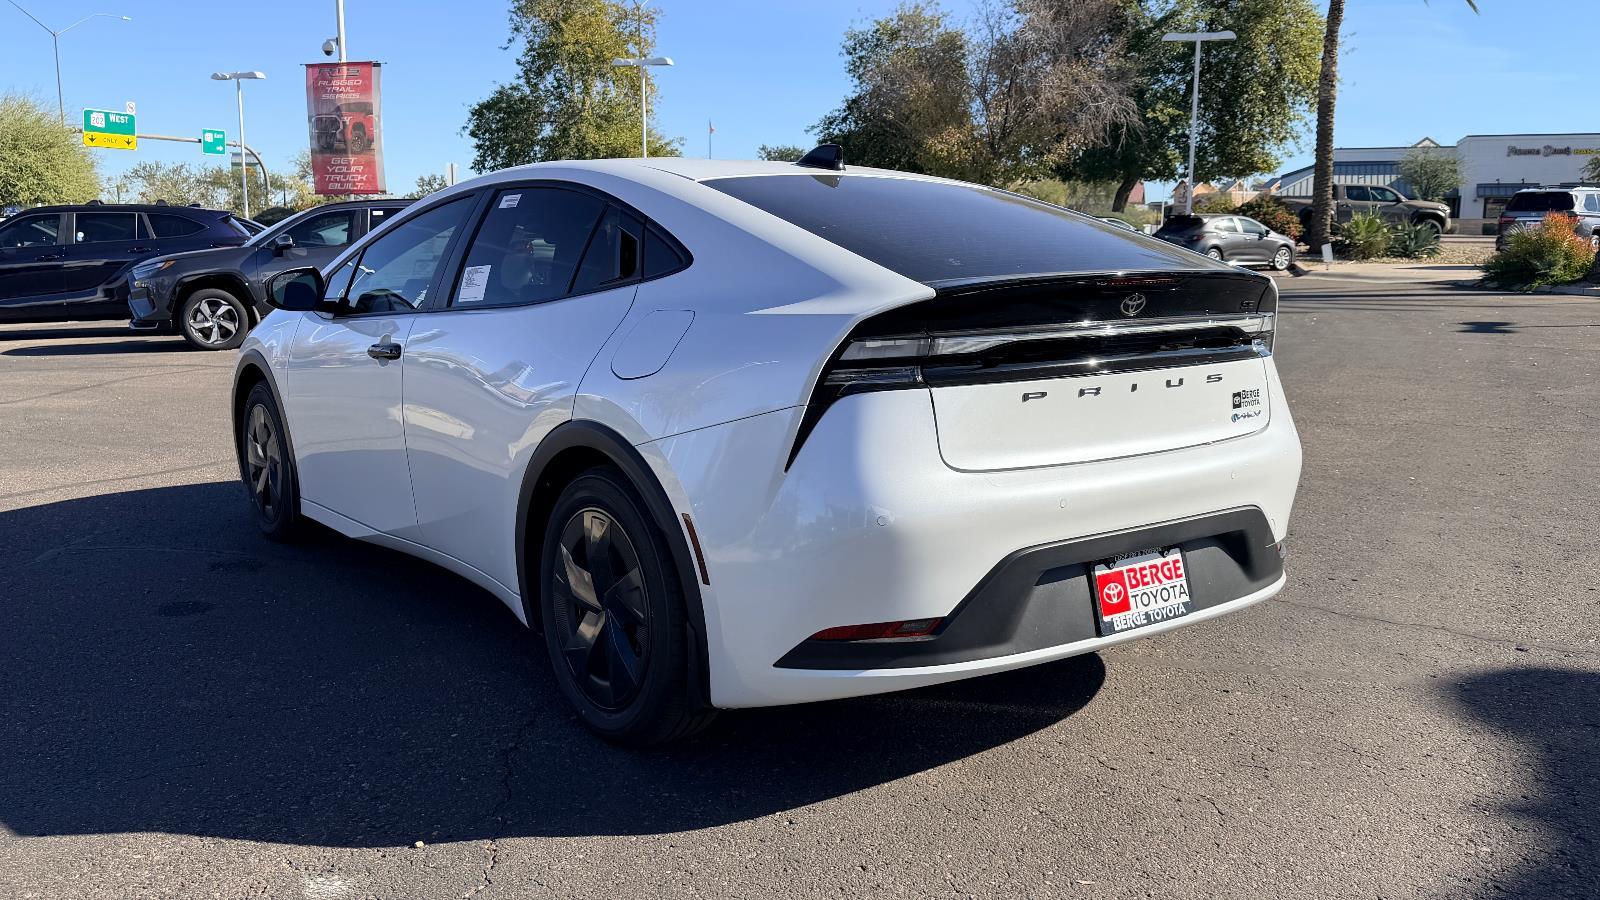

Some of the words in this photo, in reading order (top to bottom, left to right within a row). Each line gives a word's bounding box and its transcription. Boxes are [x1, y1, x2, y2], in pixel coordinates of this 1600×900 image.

[91, 116, 104, 126] 202
[109, 113, 128, 124] WEST
[331, 157, 358, 165] GET
[1022, 374, 1223, 402] PRIUS
[1241, 389, 1260, 400] BERGE
[1241, 399, 1261, 408] TOYOTA
[1126, 559, 1183, 589] BERGE
[1131, 583, 1188, 609] TOYOTA
[1113, 612, 1147, 631] BERGE
[1150, 604, 1186, 622] TOYOTA
